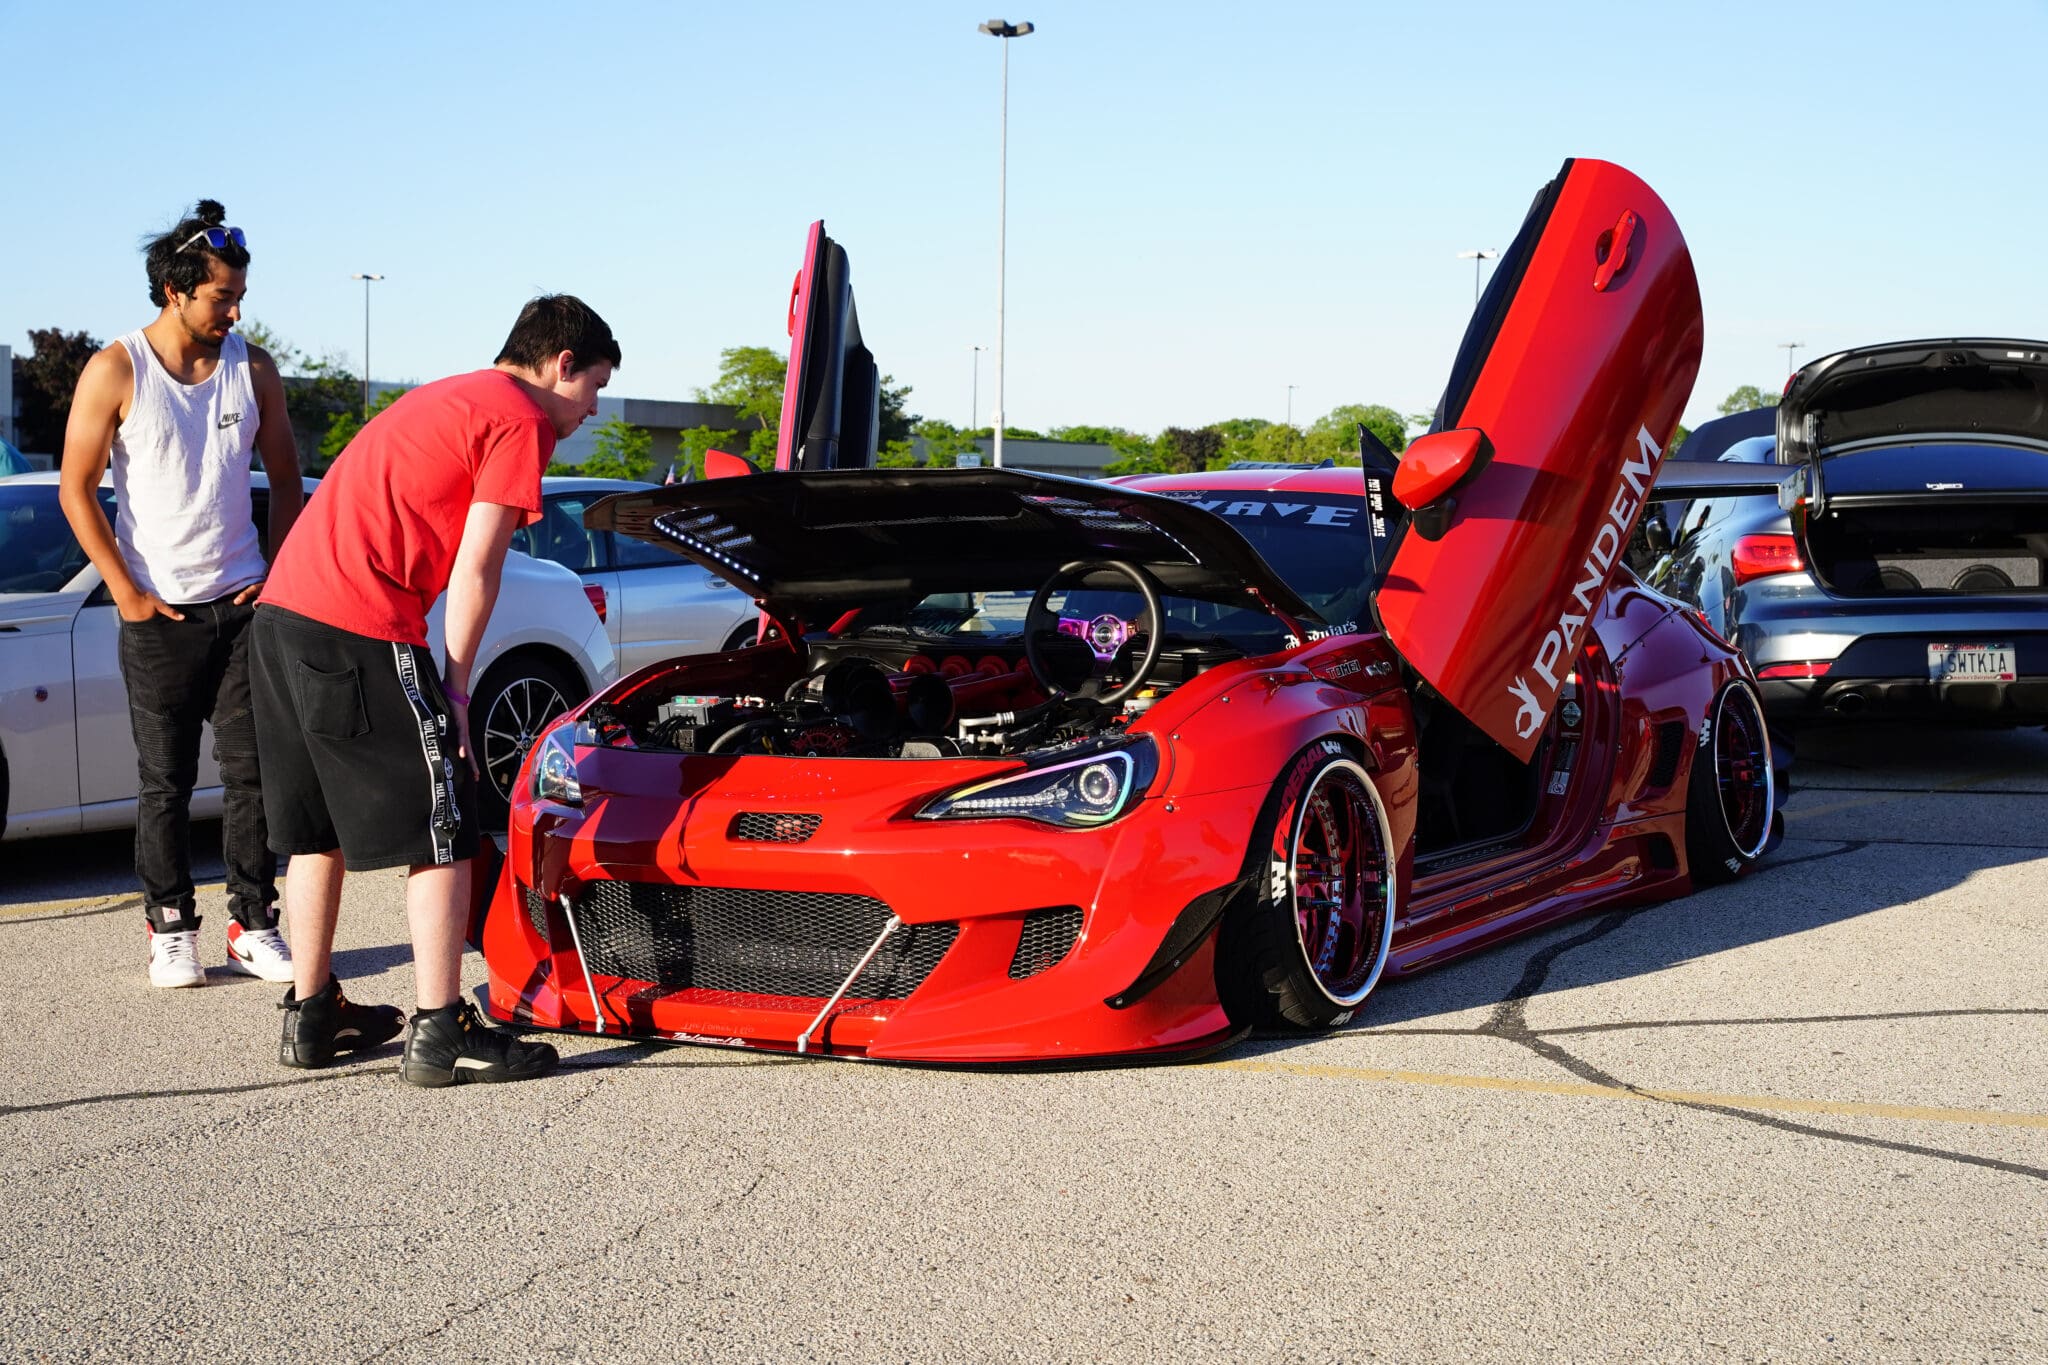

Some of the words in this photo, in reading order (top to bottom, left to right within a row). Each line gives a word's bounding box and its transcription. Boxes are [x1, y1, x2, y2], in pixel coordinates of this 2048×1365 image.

[222, 412, 241, 422] NIKE
[1532, 423, 1663, 692] PANDEM
[399, 652, 419, 701] HOLLISTER
[1326, 658, 1362, 679] TOMEI
[422, 719, 441, 762] HOLLISTER
[433, 782, 445, 828] HOLLISTER
[282, 1047, 292, 1056] 23
[673, 1032, 691, 1041] The
